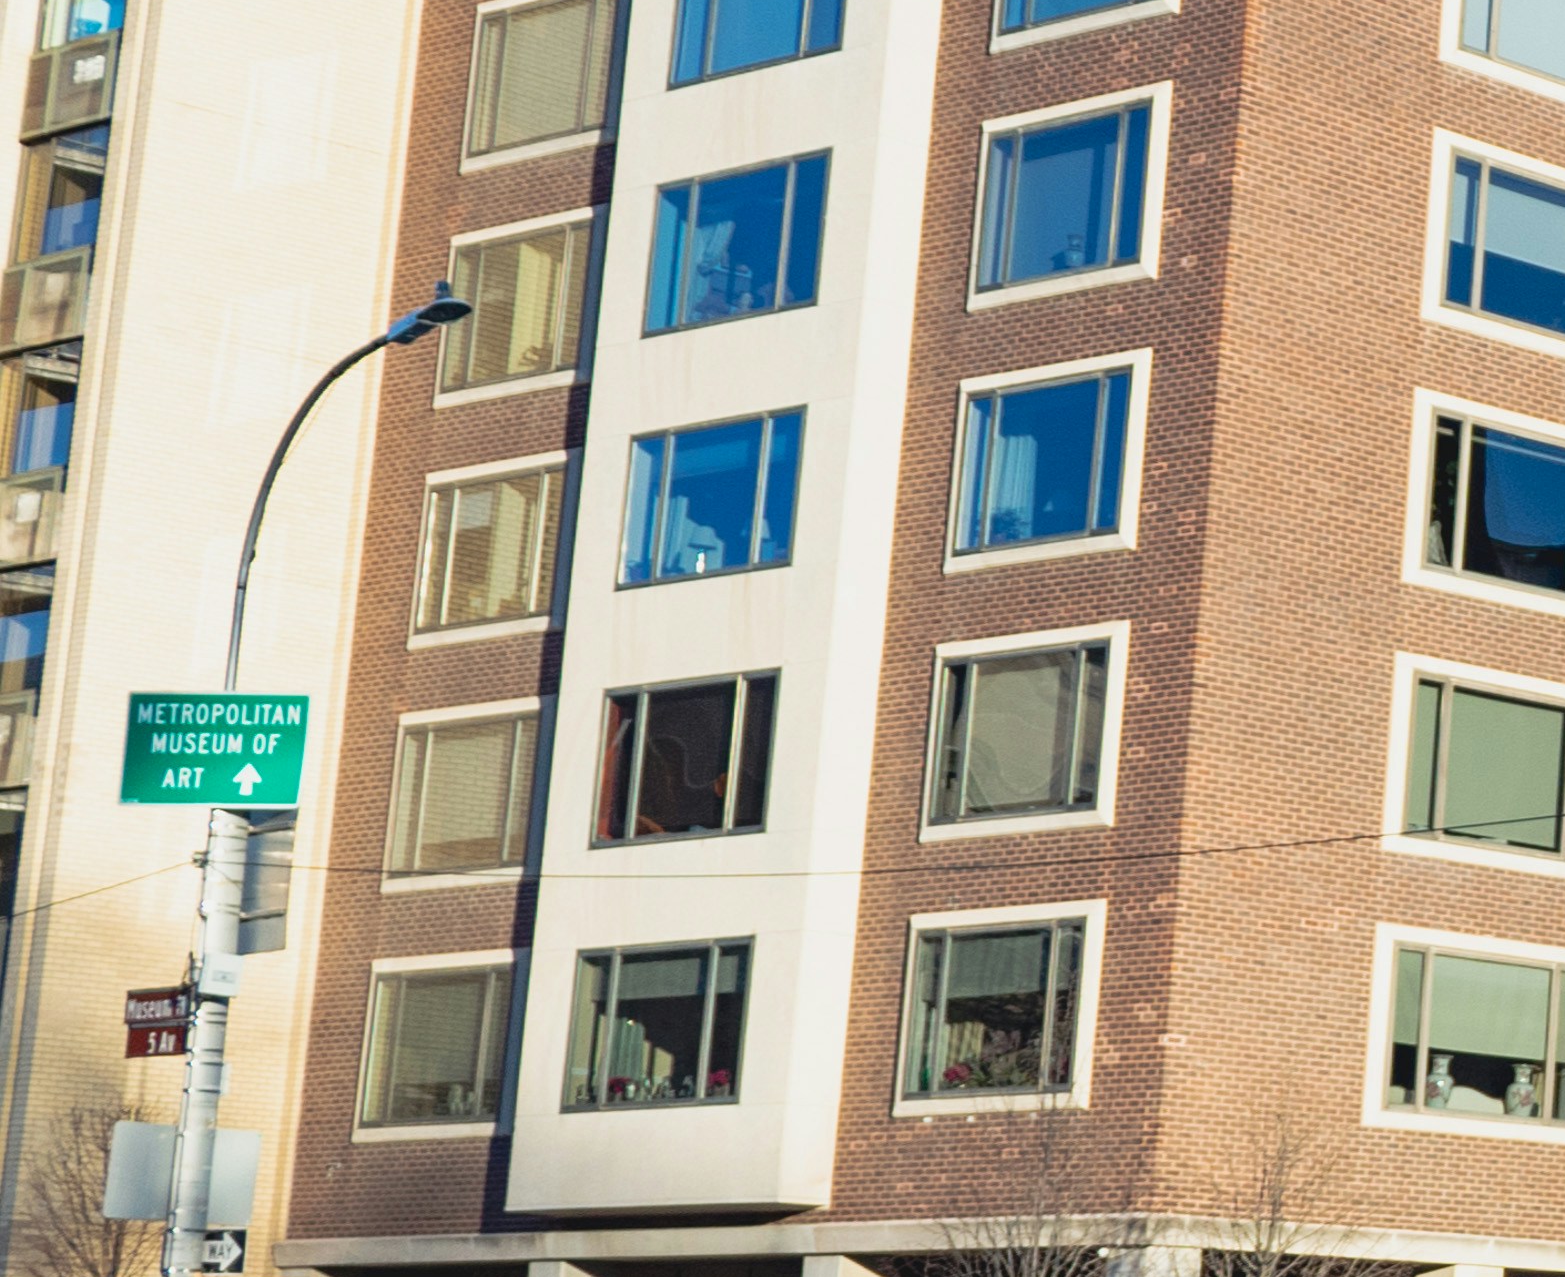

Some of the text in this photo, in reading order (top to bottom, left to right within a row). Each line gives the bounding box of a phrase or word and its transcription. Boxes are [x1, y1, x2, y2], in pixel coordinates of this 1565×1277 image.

[137, 702, 302, 726] METROPOLITAN
[150, 732, 282, 755] MUSEUM OF
[161, 767, 205, 789] ART
[146, 1031, 158, 1054] 5
[207, 1243, 234, 1260] WAY
